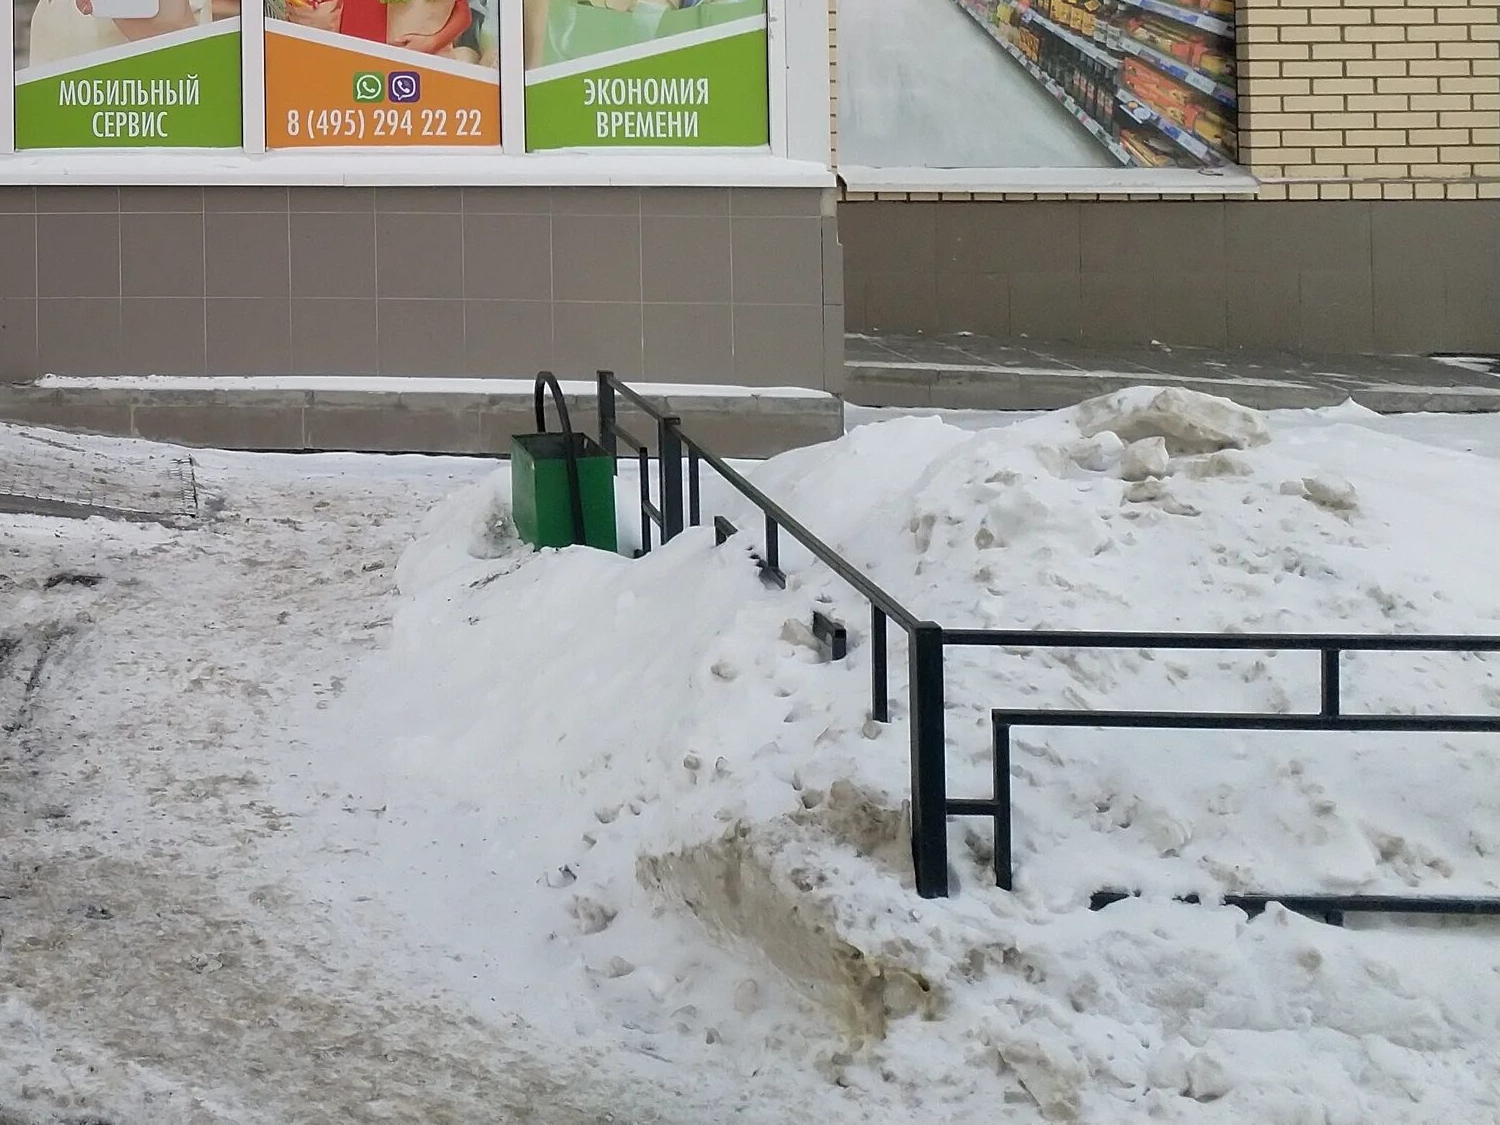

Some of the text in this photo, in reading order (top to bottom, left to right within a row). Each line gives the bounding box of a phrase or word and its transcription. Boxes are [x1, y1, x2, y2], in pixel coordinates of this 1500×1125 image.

[59, 74, 200, 106] МОБИЛЬНЫЙ
[583, 78, 709, 105] ЭКОНОМИЯ
[92, 111, 168, 137] СЕРВИС
[287, 109, 482, 139] 8 (495) 294 22 22
[596, 111, 699, 138] ВРЕМЕНИ
